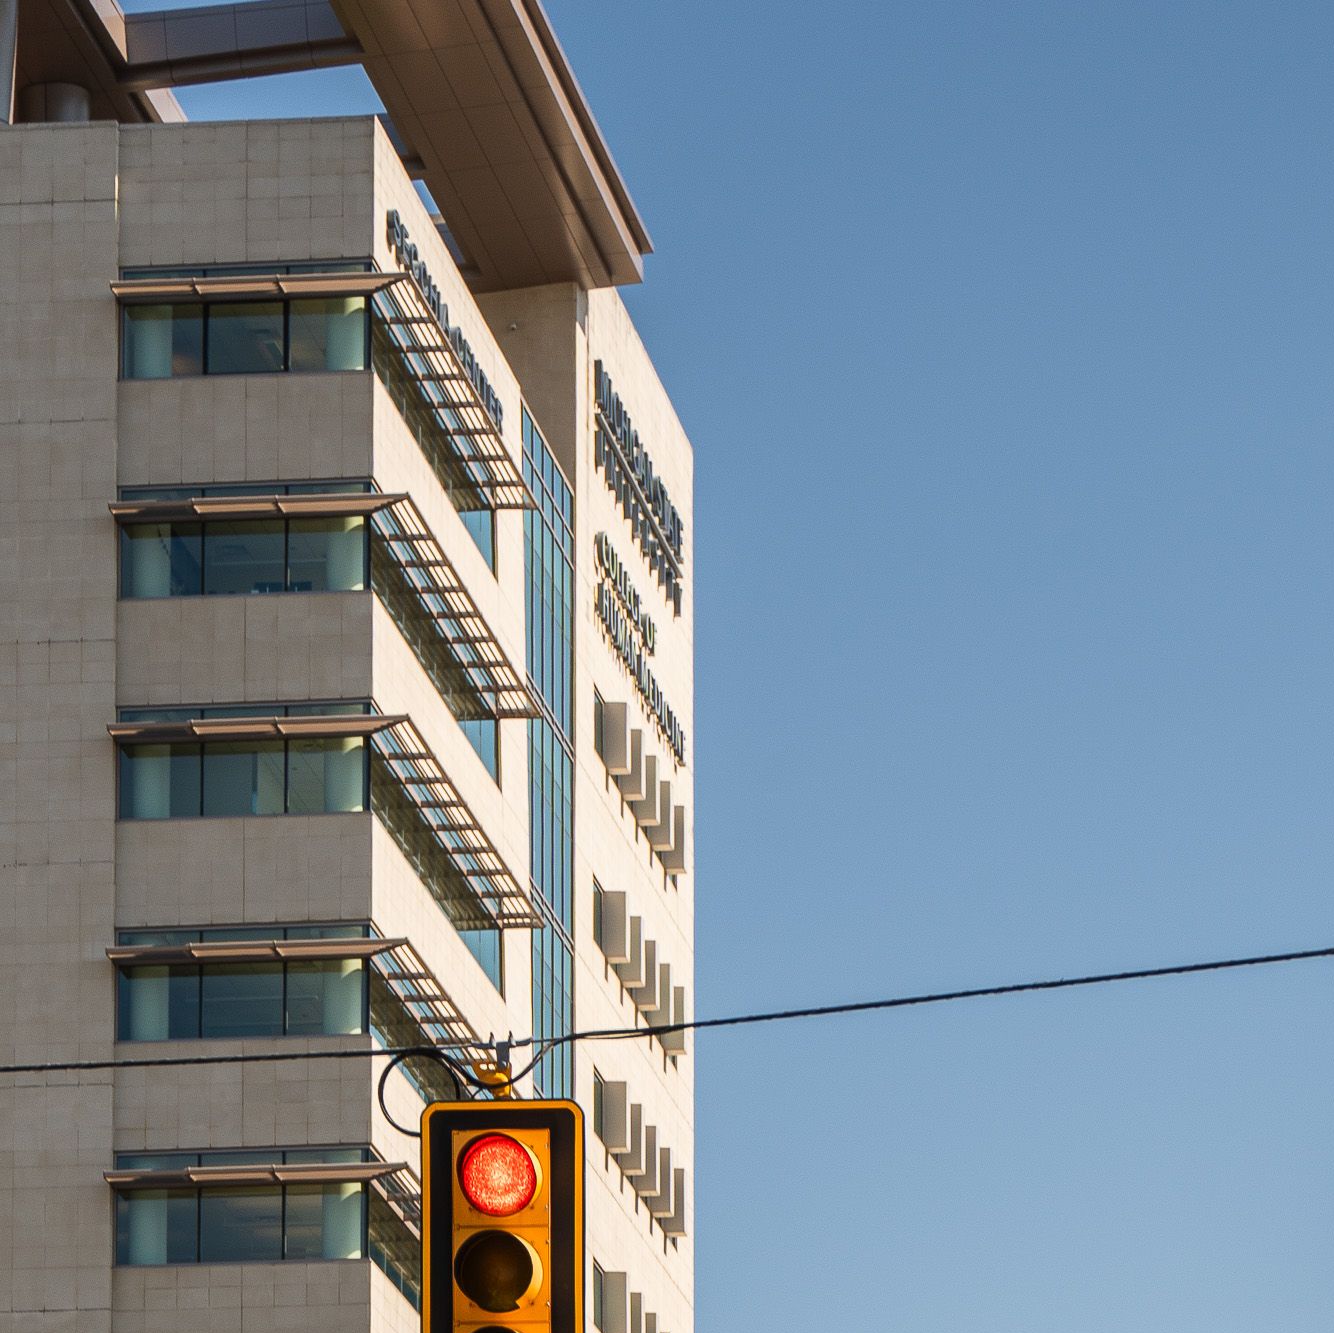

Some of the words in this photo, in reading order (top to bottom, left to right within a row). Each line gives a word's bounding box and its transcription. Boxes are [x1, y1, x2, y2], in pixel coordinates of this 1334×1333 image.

[594, 359, 653, 504] MICHIGAN
[651, 476, 684, 564] STATE
[594, 531, 642, 633] COLLEGE
[594, 582, 640, 677] HUMAN
[636, 648, 686, 766] MEDICINE
